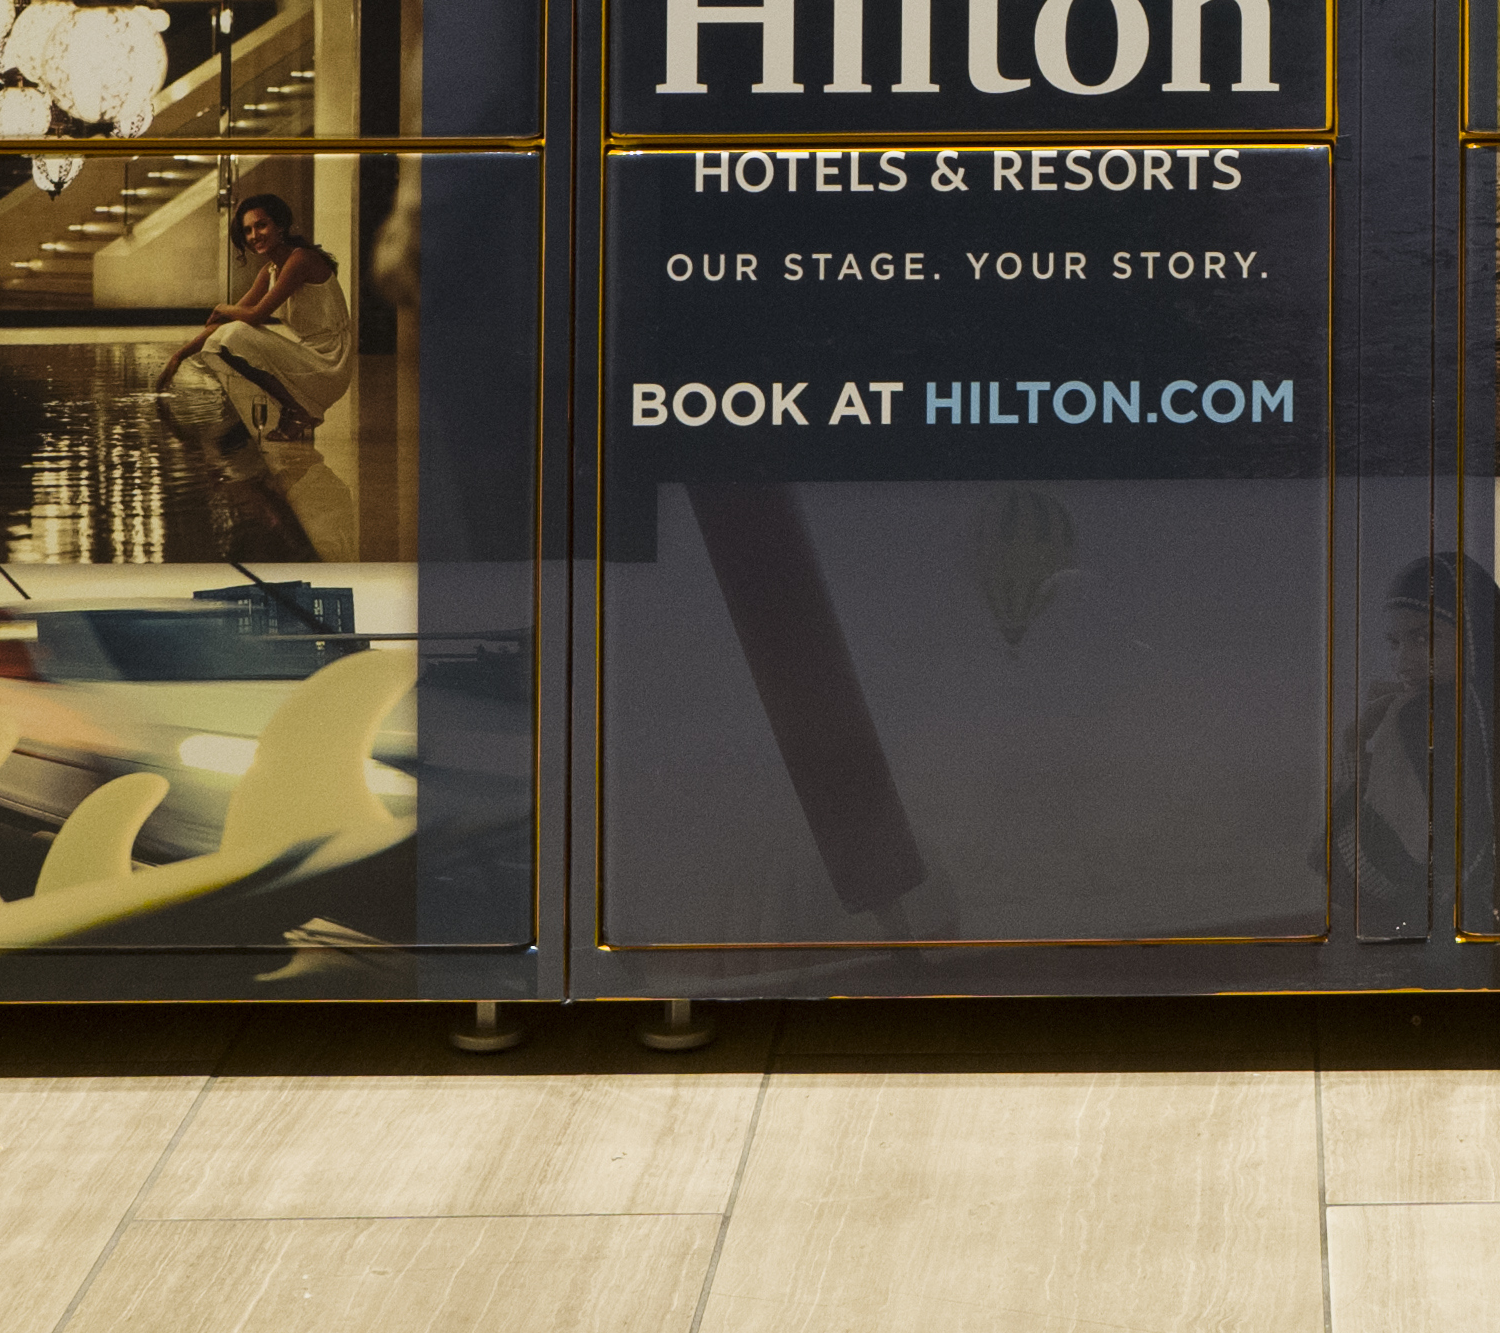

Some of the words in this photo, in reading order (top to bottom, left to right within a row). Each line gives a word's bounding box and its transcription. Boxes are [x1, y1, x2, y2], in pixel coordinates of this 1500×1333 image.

[694, 149, 908, 193] HOTELS
[930, 149, 970, 192] &
[992, 148, 1242, 192] RESORTS
[666, 252, 758, 282] OUR
[783, 252, 941, 281] STAGE.
[966, 250, 1088, 281] YOUR
[1112, 250, 1269, 280] STORY.
[632, 381, 810, 426] BOOK
[828, 381, 904, 425] AT
[925, 379, 1295, 424] HILTON.COM
